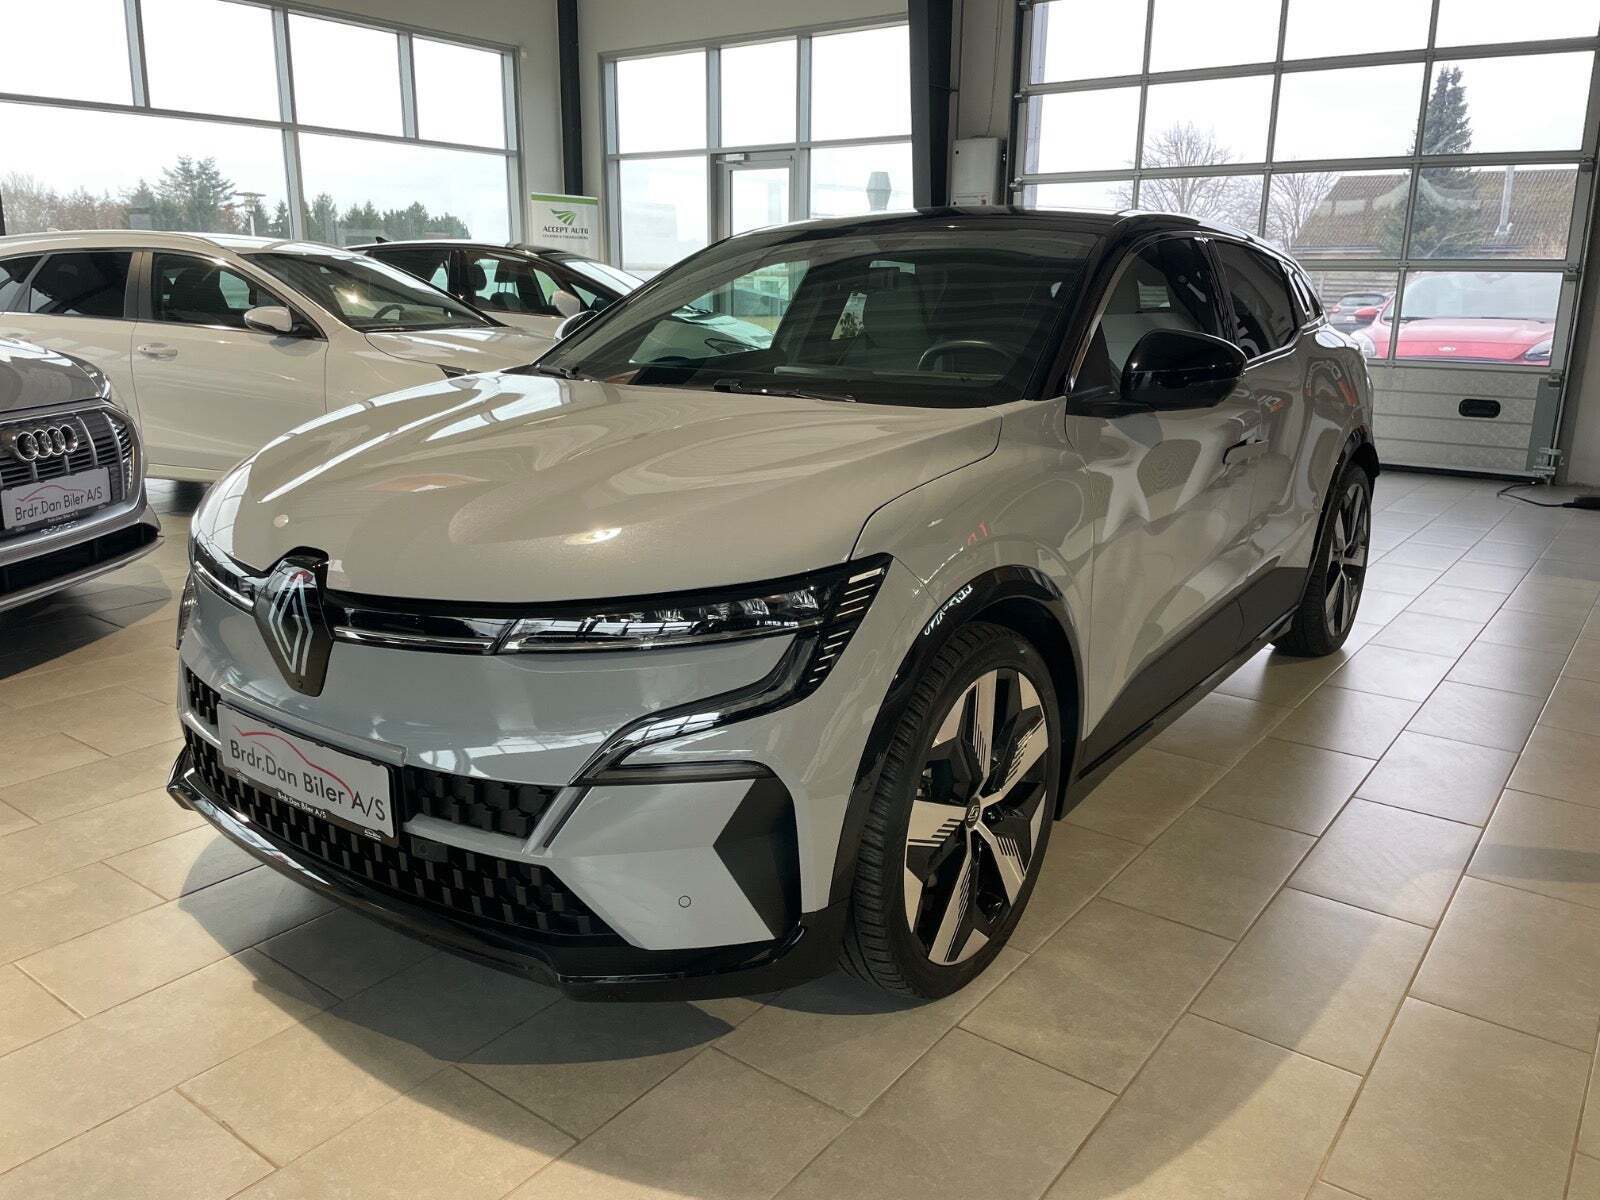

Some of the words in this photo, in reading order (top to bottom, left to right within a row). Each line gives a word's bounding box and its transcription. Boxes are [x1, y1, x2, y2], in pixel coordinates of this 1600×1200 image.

[543, 225, 568, 233] ACCEPT
[15, 501, 62, 521] Brdr.Dan
[63, 493, 84, 509] Biler
[87, 486, 103, 503] A/S
[230, 739, 298, 788] Brdr.Dan
[303, 772, 346, 805] Biler
[351, 791, 386, 821] A/S
